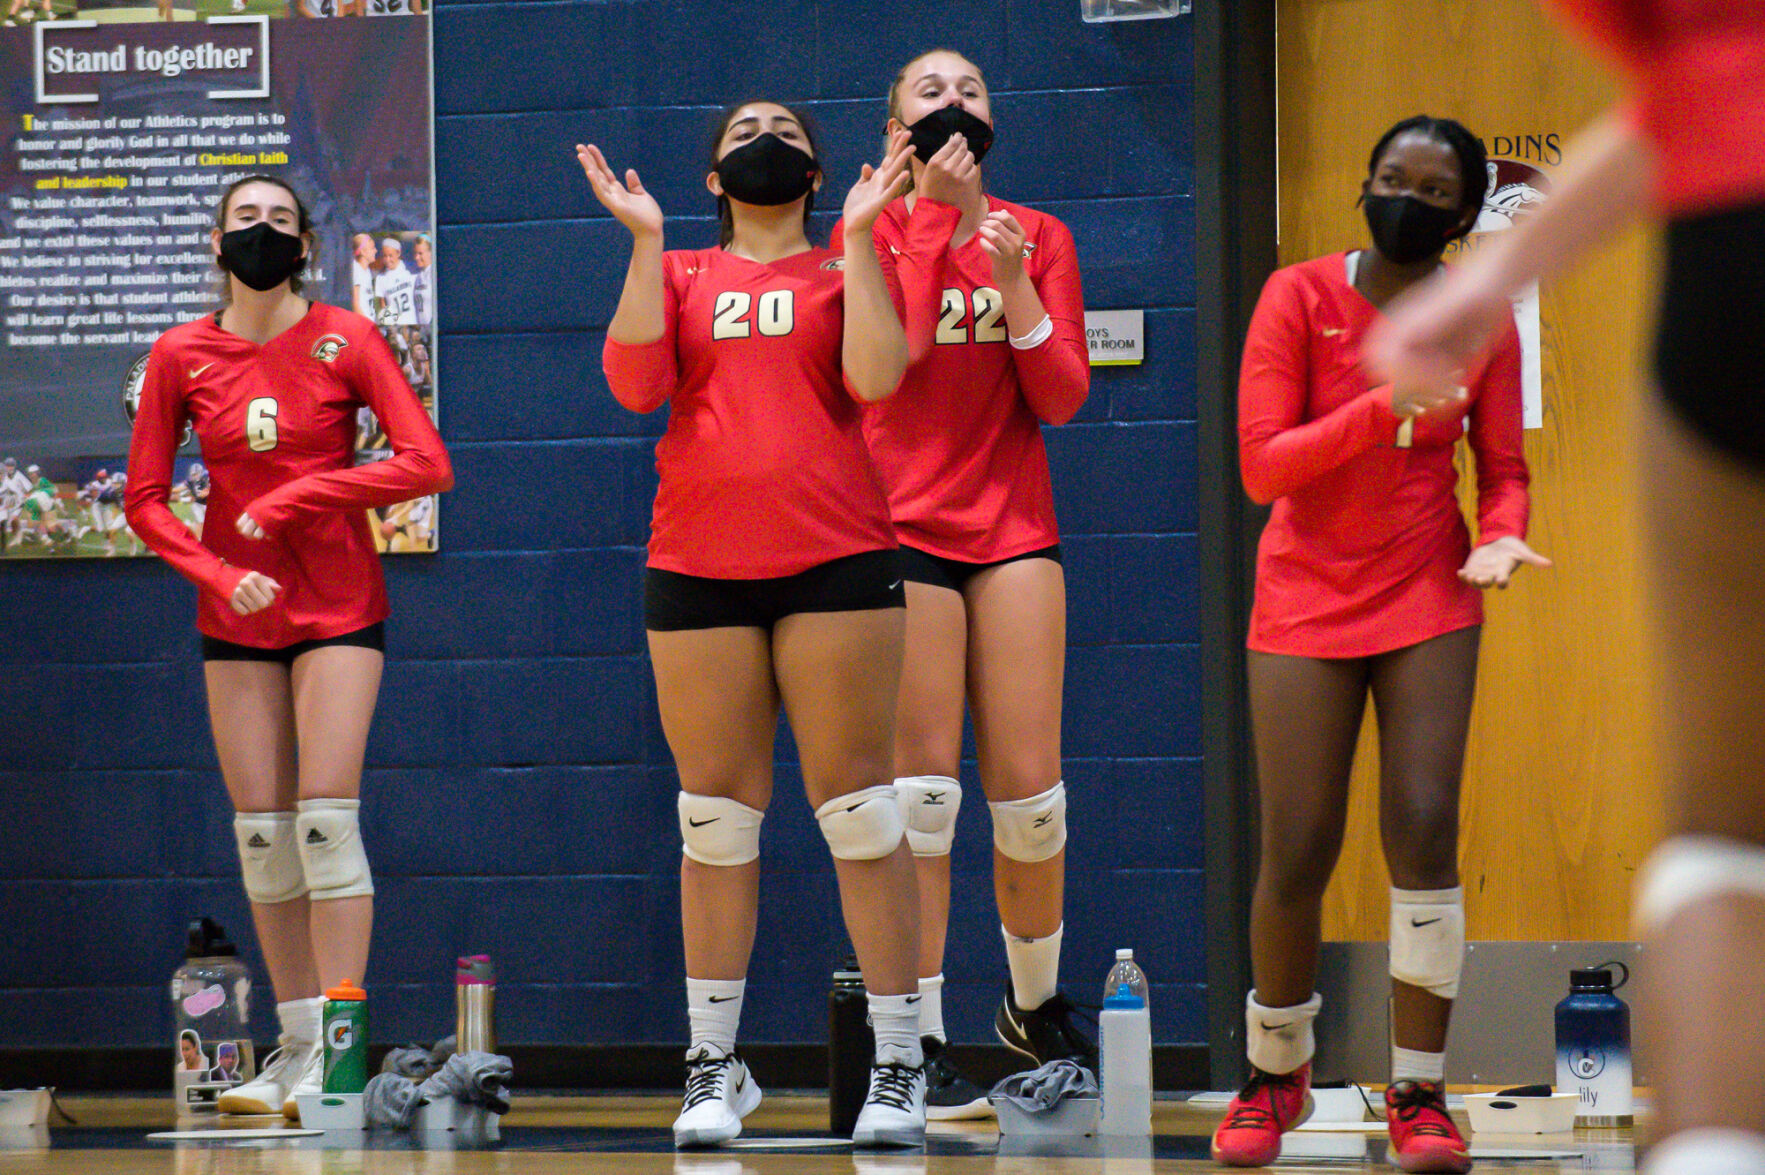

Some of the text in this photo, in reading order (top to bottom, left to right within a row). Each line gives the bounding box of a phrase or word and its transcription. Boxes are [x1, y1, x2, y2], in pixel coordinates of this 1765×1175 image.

[47, 42, 253, 76] Stand together
[23, 112, 286, 131] The mission of our Athletics program is to
[17, 132, 291, 151] honor and glorify God in all that we do while
[1481, 133, 1562, 166] DINS
[20, 151, 289, 172] fostering the development of Christian faith
[36, 176, 60, 189] and
[62, 175, 128, 190] leadership
[130, 174, 144, 187] in
[146, 176, 169, 187] our
[171, 172, 219, 186] student
[10, 196, 31, 209] We
[33, 196, 67, 208] value
[23, 237, 42, 248] we
[44, 234, 74, 247] extol
[77, 234, 111, 246] these
[113, 233, 153, 246] values
[156, 235, 172, 245] on
[175, 232, 199, 245] and
[21, 254, 66, 267] believe
[67, 254, 82, 266] in
[83, 253, 132, 268] striving
[133, 252, 153, 265] for
[39, 273, 81, 286] realize
[83, 273, 108, 286] and
[110, 272, 169, 285] maximize
[171, 271, 202, 284] their
[10, 294, 35, 307] Our
[37, 293, 77, 306] desire
[78, 293, 92, 306] is
[93, 292, 119, 305] that
[121, 292, 169, 304] student
[6, 313, 29, 326] will
[31, 313, 65, 325] learn
[66, 313, 101, 328] great
[103, 311, 125, 324] life
[126, 311, 174, 324] lessons
[712, 289, 795, 341] 20
[935, 286, 1008, 345] 22
[8, 333, 58, 345] become
[59, 332, 82, 345] the
[83, 331, 130, 344] servant
[1084, 327, 1109, 338] OYS
[1101, 339, 1135, 350] ROOM
[247, 396, 279, 453] 6
[328, 1018, 353, 1051] G
